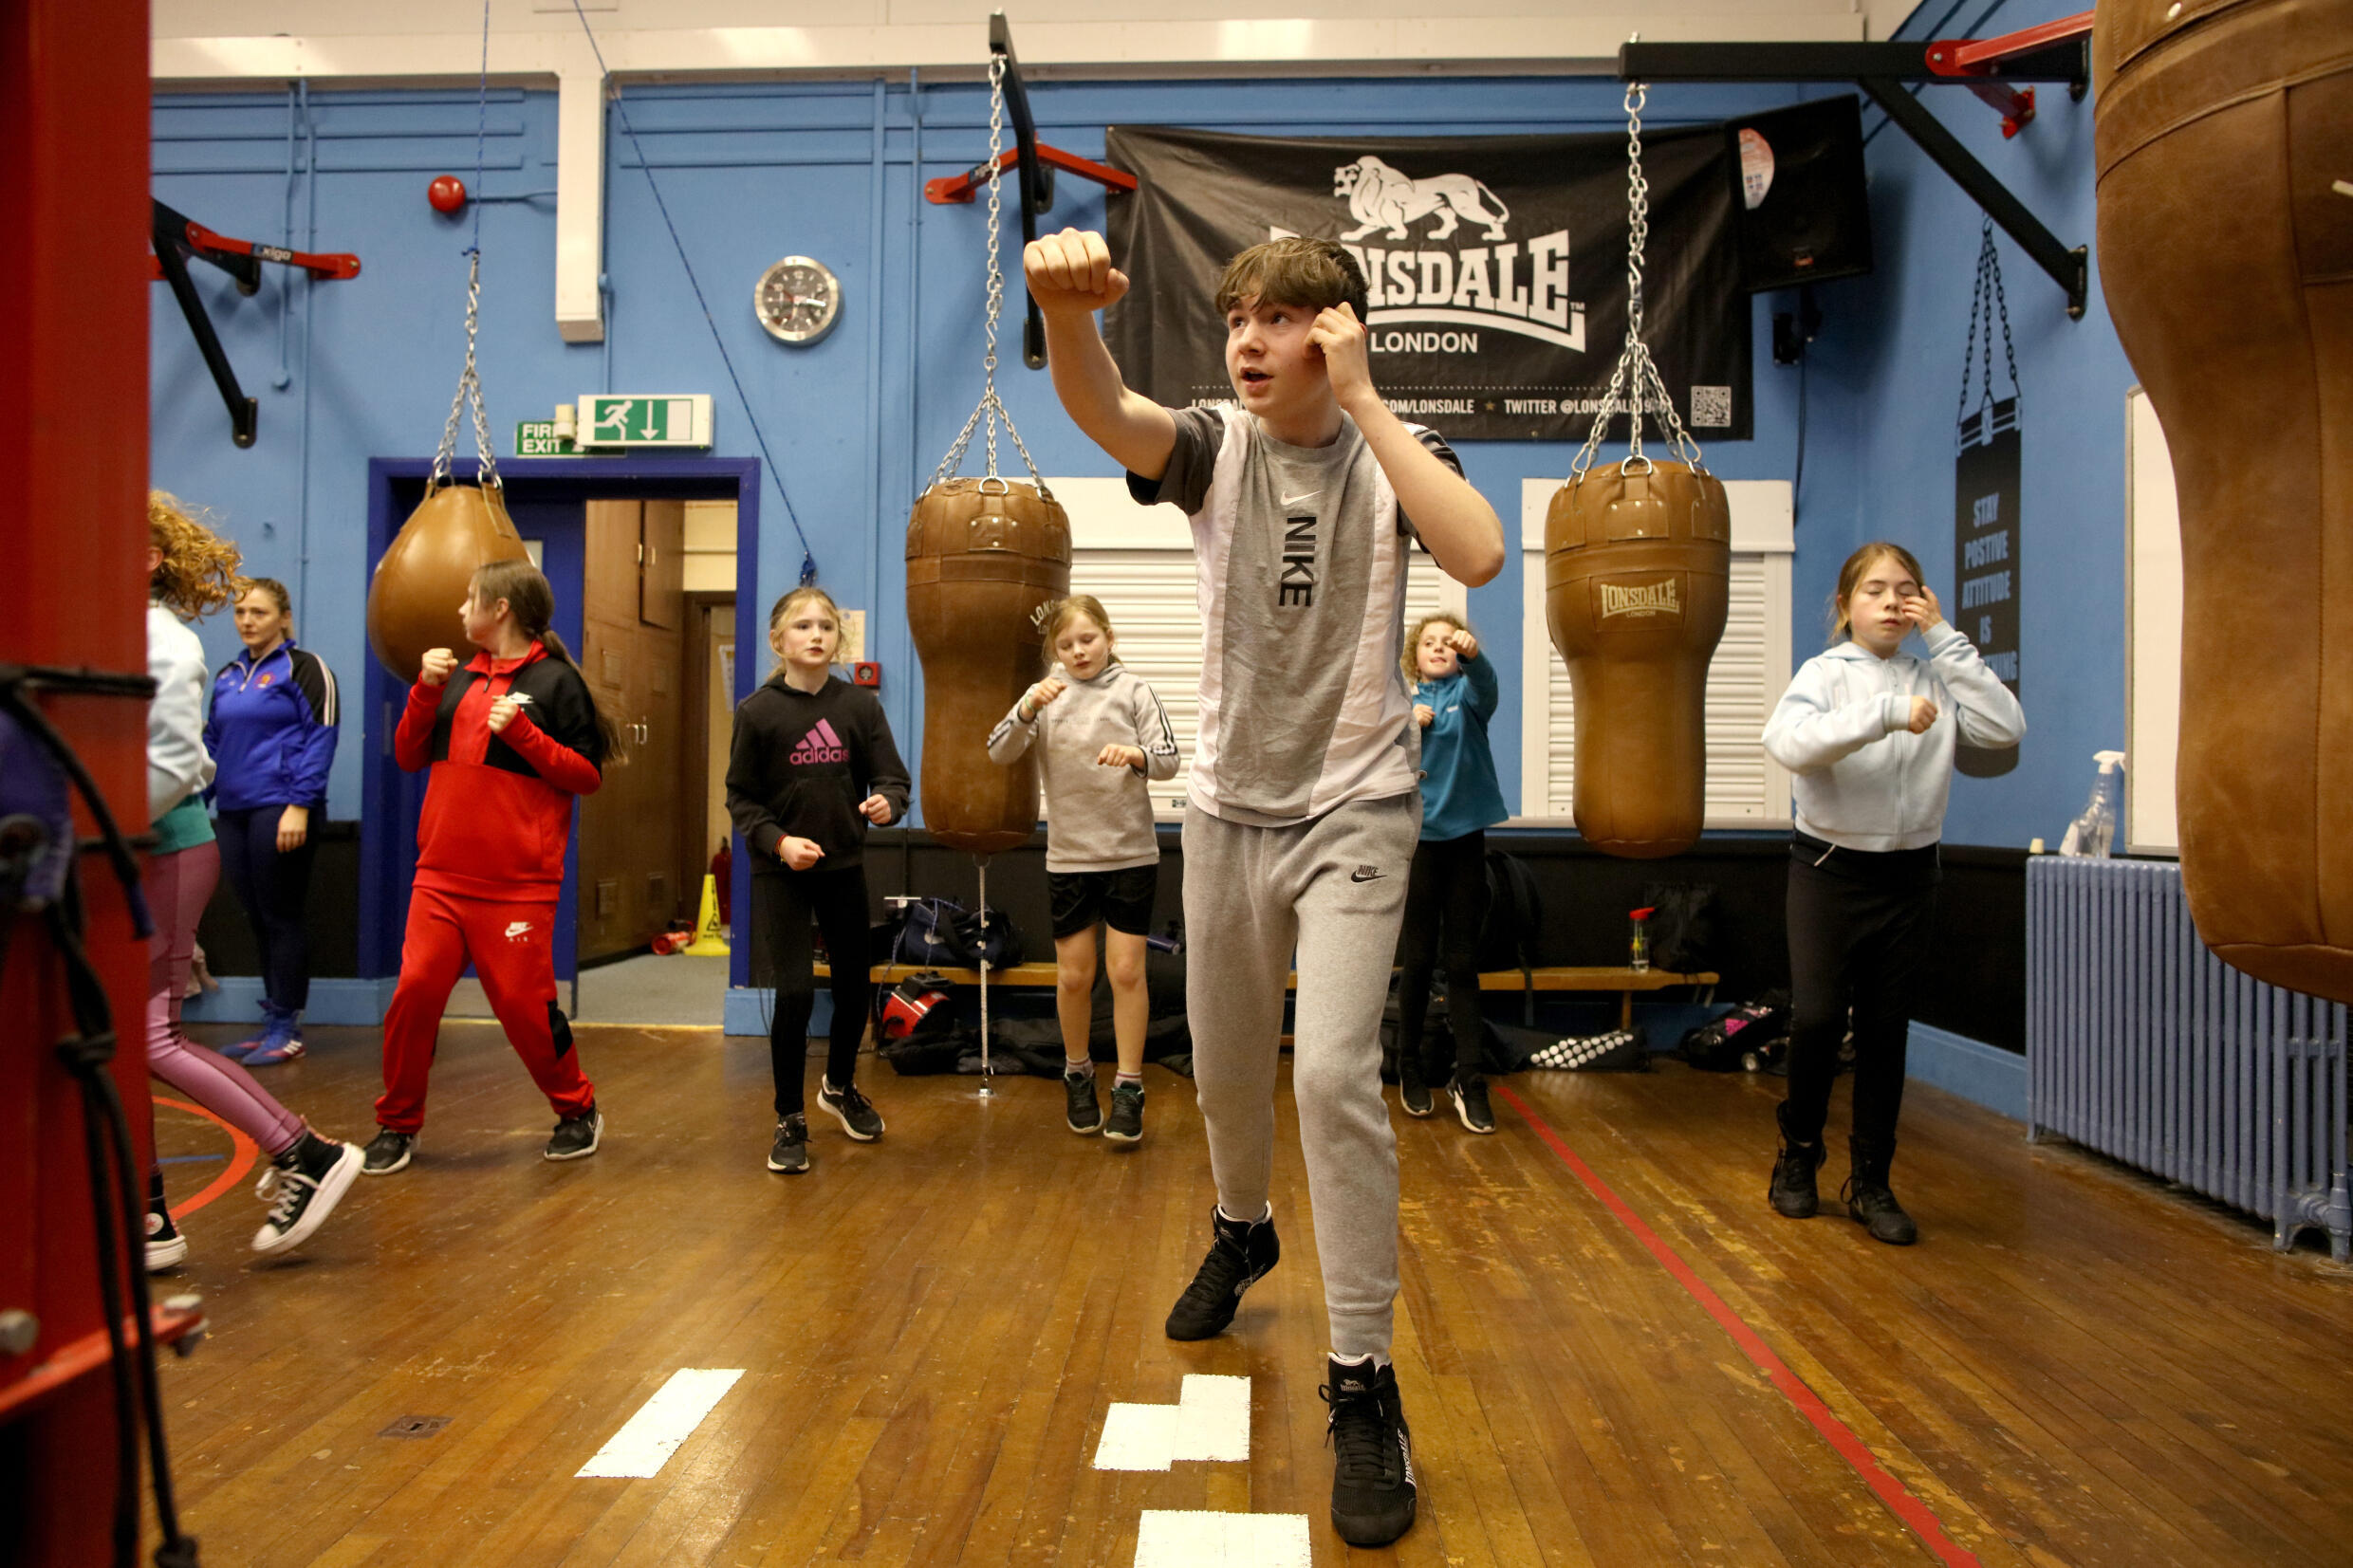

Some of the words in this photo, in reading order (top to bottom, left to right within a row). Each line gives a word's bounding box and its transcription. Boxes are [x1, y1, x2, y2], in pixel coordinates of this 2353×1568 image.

[1269, 226, 1570, 332] NSDALE
[1370, 332, 1478, 353] LONDON
[1504, 399, 1557, 414] TWITTER
[523, 423, 558, 438] FIR
[523, 439, 560, 453] EXIT
[1973, 492, 1999, 528] STAY
[1279, 516, 1317, 607] NIKE
[1601, 578, 1679, 618] LONSDALE
[1961, 570, 2011, 610] ATTITUDE
[1979, 616, 1992, 644] IS
[789, 747, 850, 766] adidas
[1358, 864, 1379, 877] NIKE
